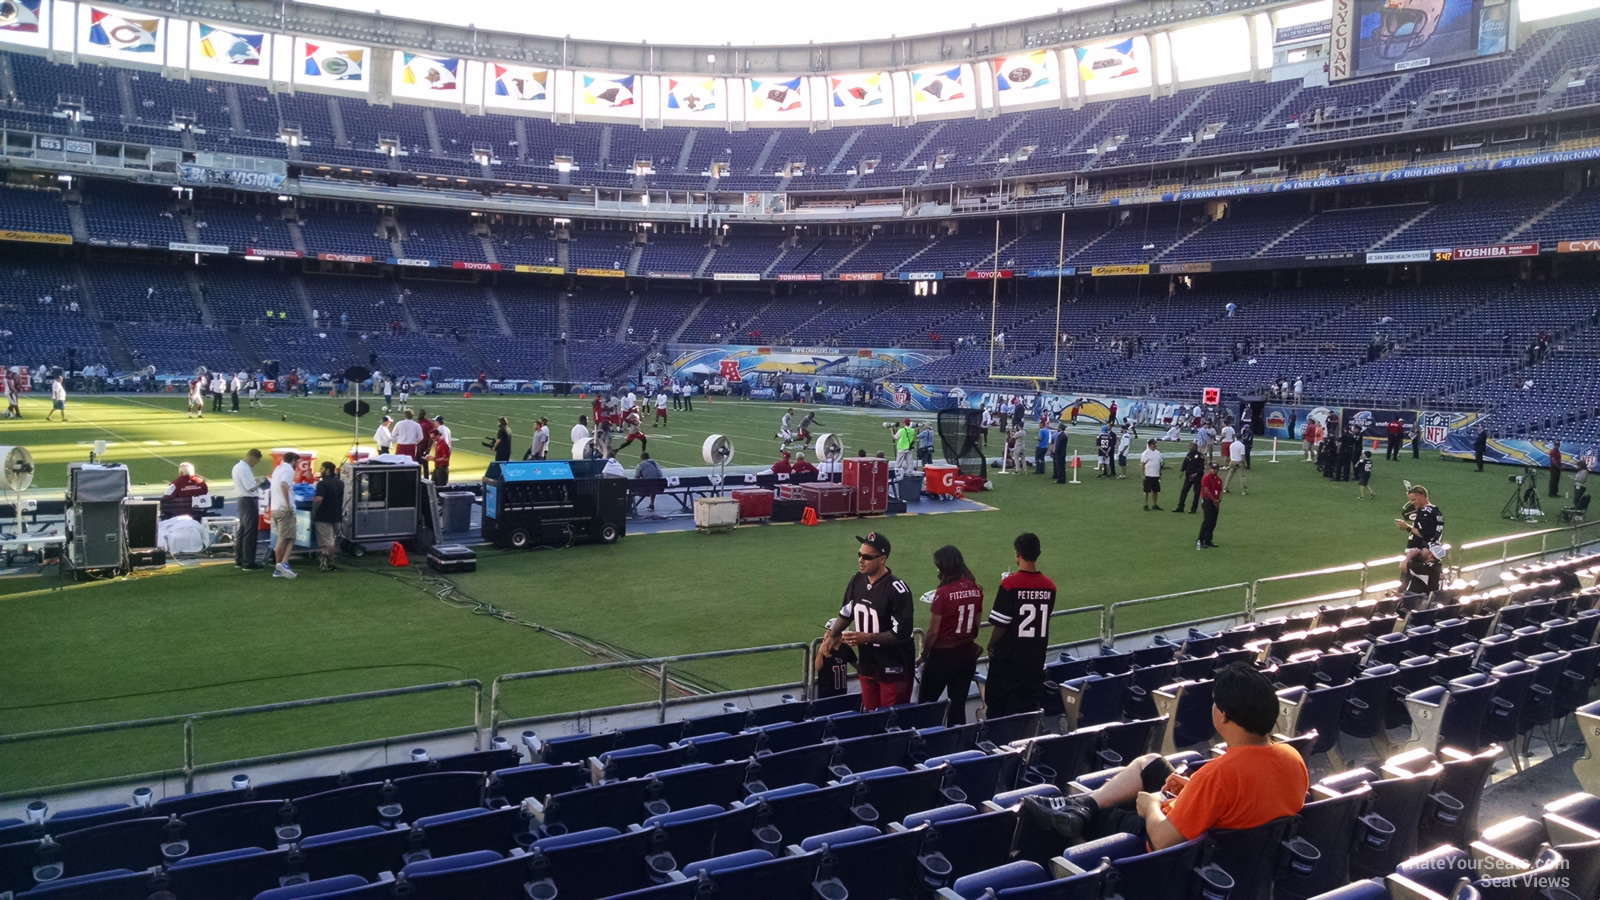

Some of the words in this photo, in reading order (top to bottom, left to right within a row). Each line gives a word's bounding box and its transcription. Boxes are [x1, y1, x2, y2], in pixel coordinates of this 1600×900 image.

[1334, 0, 1348, 77] SYCUAN
[1515, 154, 1550, 167] JACQUE
[1404, 169, 1421, 178] BOB
[1423, 165, 1458, 176] LARABA
[1294, 180, 1311, 189] EMIL
[1313, 178, 1340, 188] KARAS
[1217, 187, 1250, 197] BUNCOM
[1458, 247, 1507, 257] TOSHIBA
[325, 253, 366, 262] CYMER
[397, 258, 430, 267] GEICO
[464, 262, 492, 270] TOYOTA
[909, 272, 936, 280] GEICO
[1426, 426, 1447, 443] NFL
[298, 460, 309, 471] G
[943, 472, 953, 487] G
[949, 590, 981, 600] FITZGERALD
[1017, 590, 1051, 600] PETERSON
[955, 603, 976, 634] 11
[1018, 604, 1049, 638] 21
[1423, 711, 1428, 719] 5
